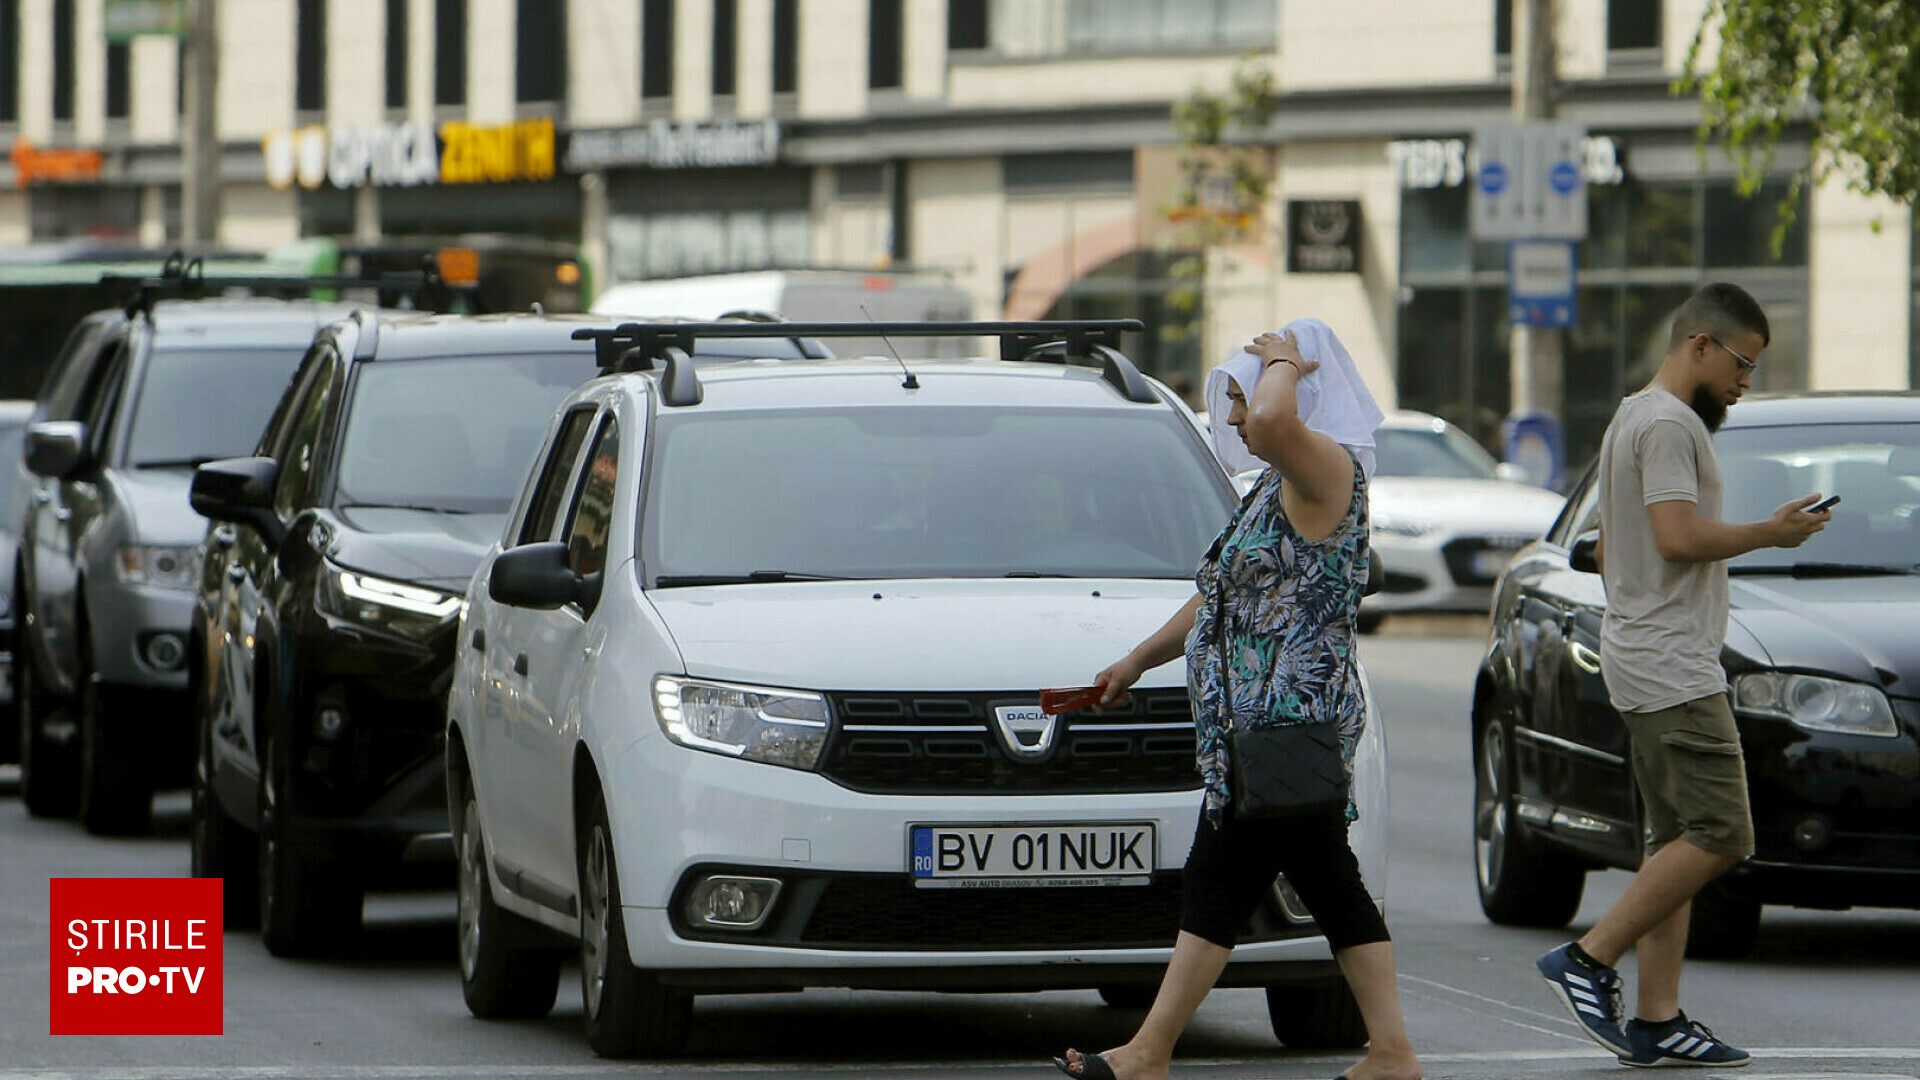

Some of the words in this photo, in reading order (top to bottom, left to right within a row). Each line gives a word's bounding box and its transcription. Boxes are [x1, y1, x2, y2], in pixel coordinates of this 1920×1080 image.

[1006, 712, 1049, 721] DACIA
[937, 833, 994, 872] BV
[914, 855, 932, 871] RO
